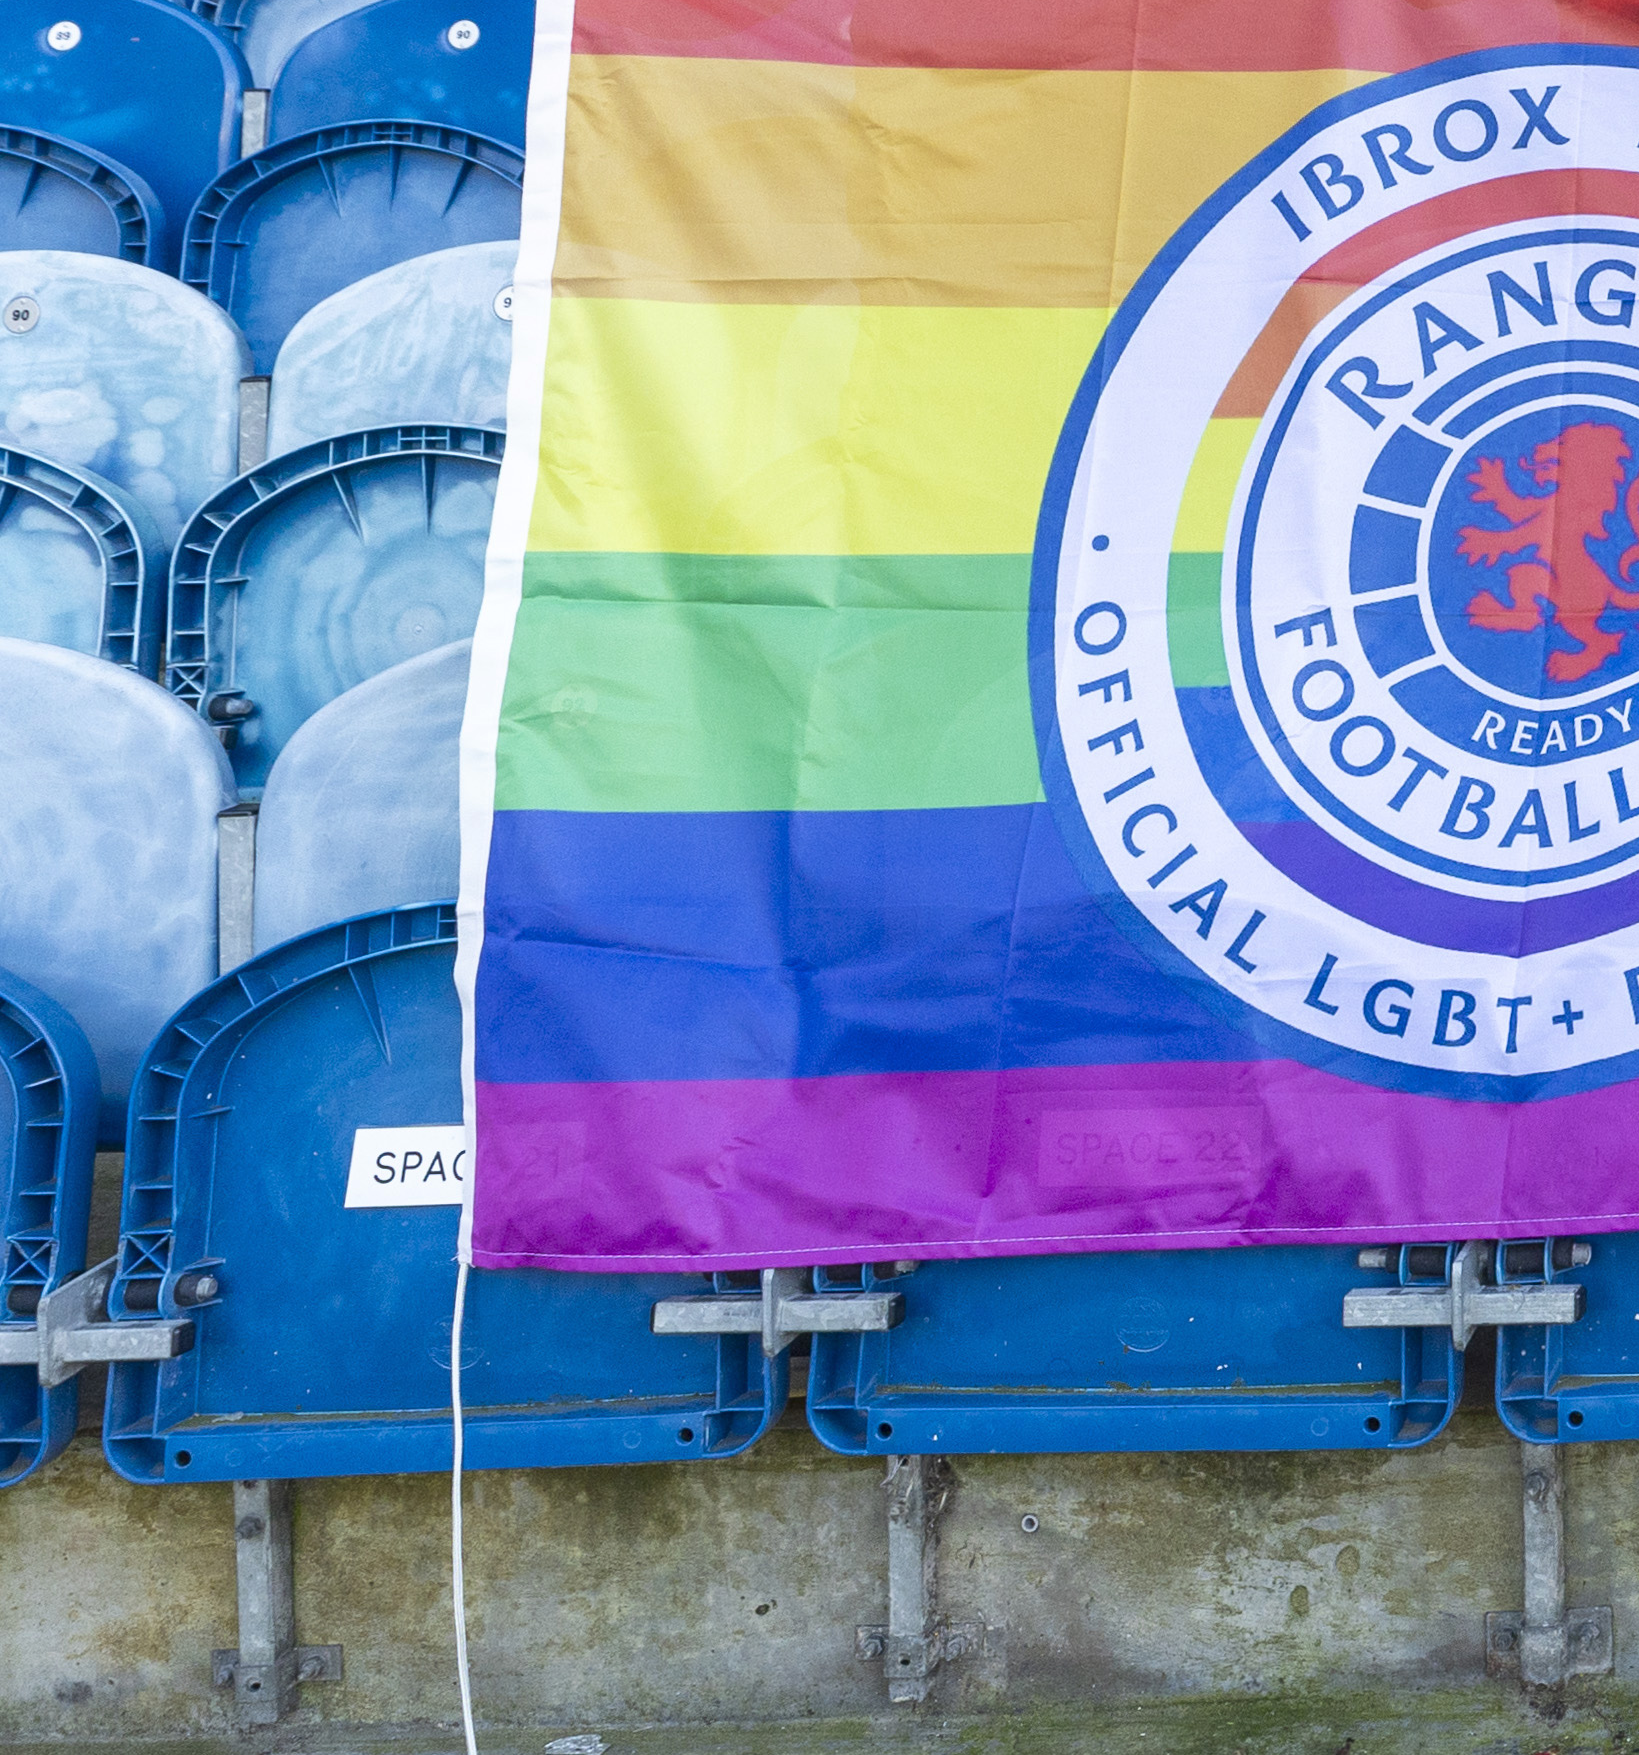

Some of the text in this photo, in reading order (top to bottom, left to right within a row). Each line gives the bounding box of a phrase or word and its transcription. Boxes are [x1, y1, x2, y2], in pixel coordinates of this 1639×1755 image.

[1269, 85, 1571, 243] IBROX
[12, 309, 30, 321] 90
[1471, 698, 1633, 756] READY
[1074, 601, 1266, 975] OFFICIAL
[1304, 951, 1584, 1055] LGBT+
[374, 1150, 465, 1184] SPAC
